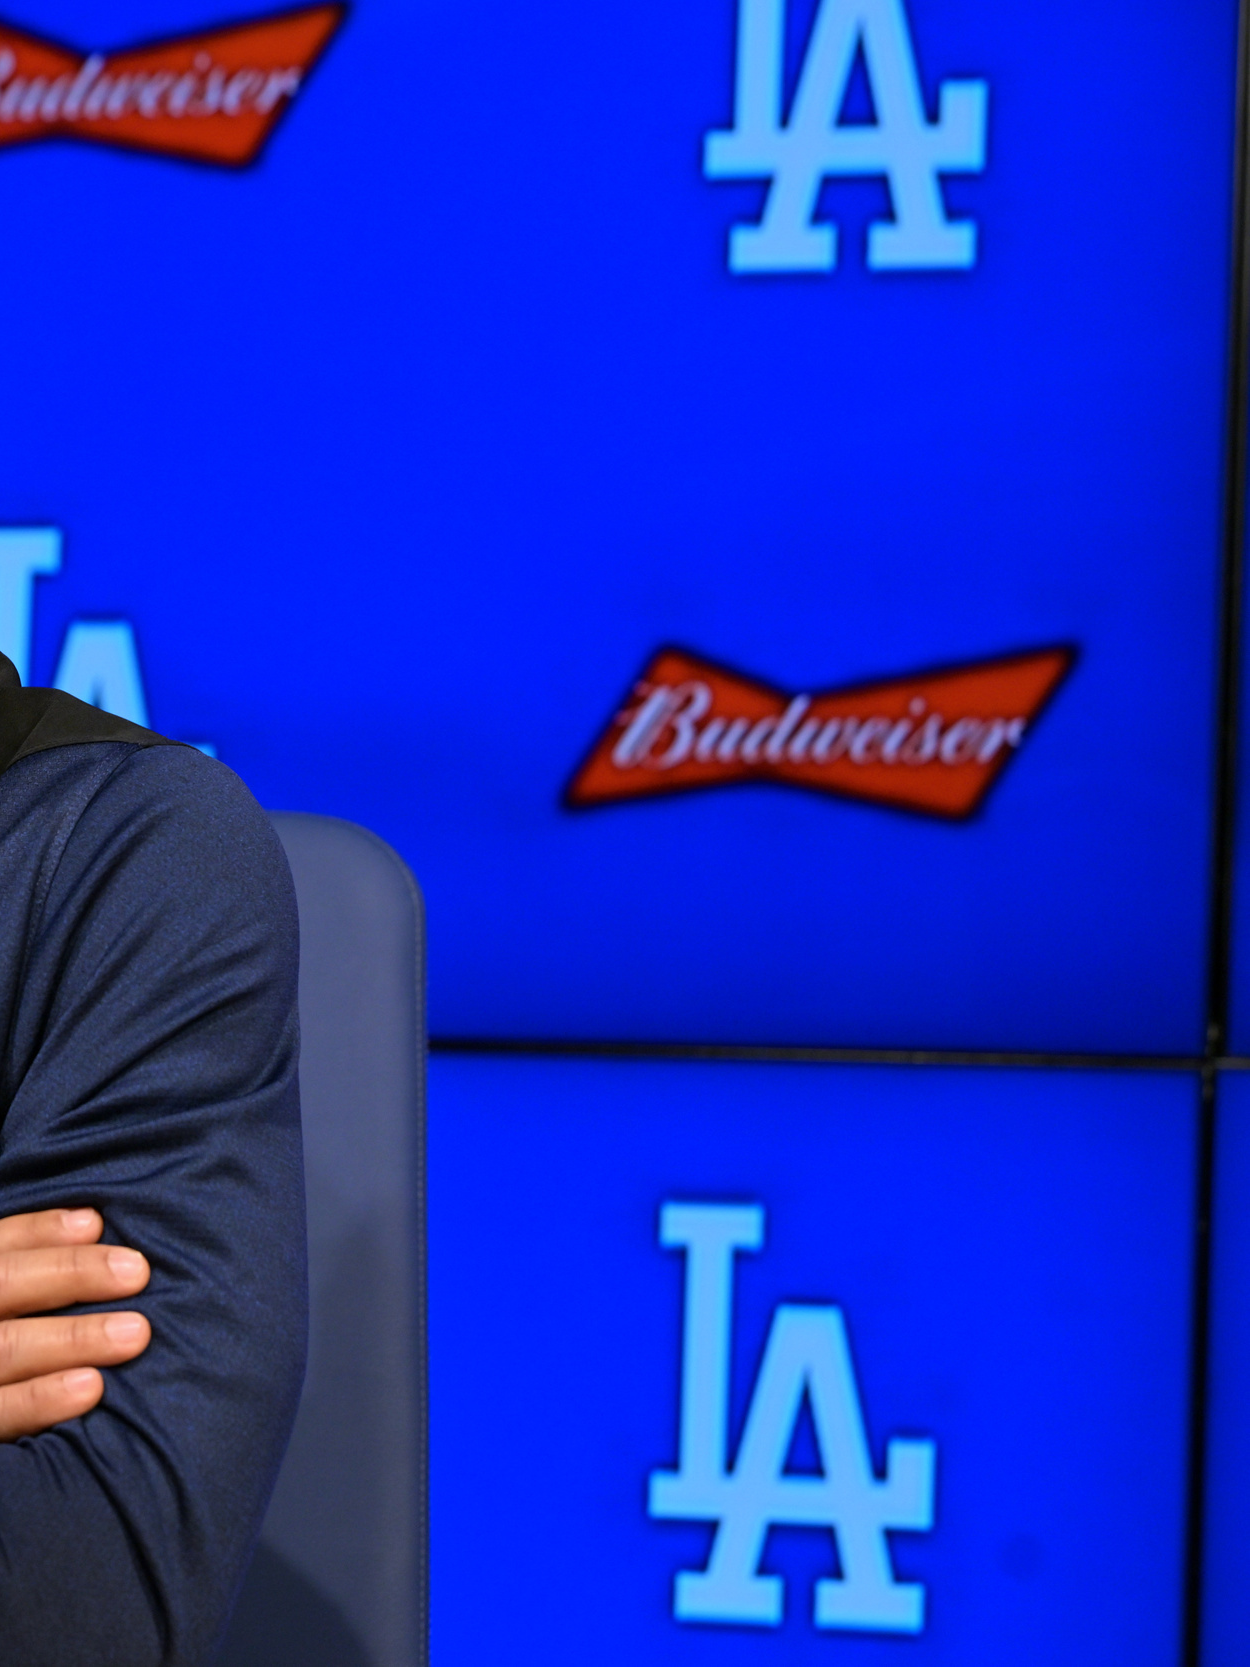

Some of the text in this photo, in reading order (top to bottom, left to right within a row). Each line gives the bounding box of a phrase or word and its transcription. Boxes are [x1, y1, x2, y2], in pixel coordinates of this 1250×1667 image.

[703, 0, 988, 275] LA
[611, 680, 1026, 769] Budweiser
[648, 1202, 936, 1633] LA
